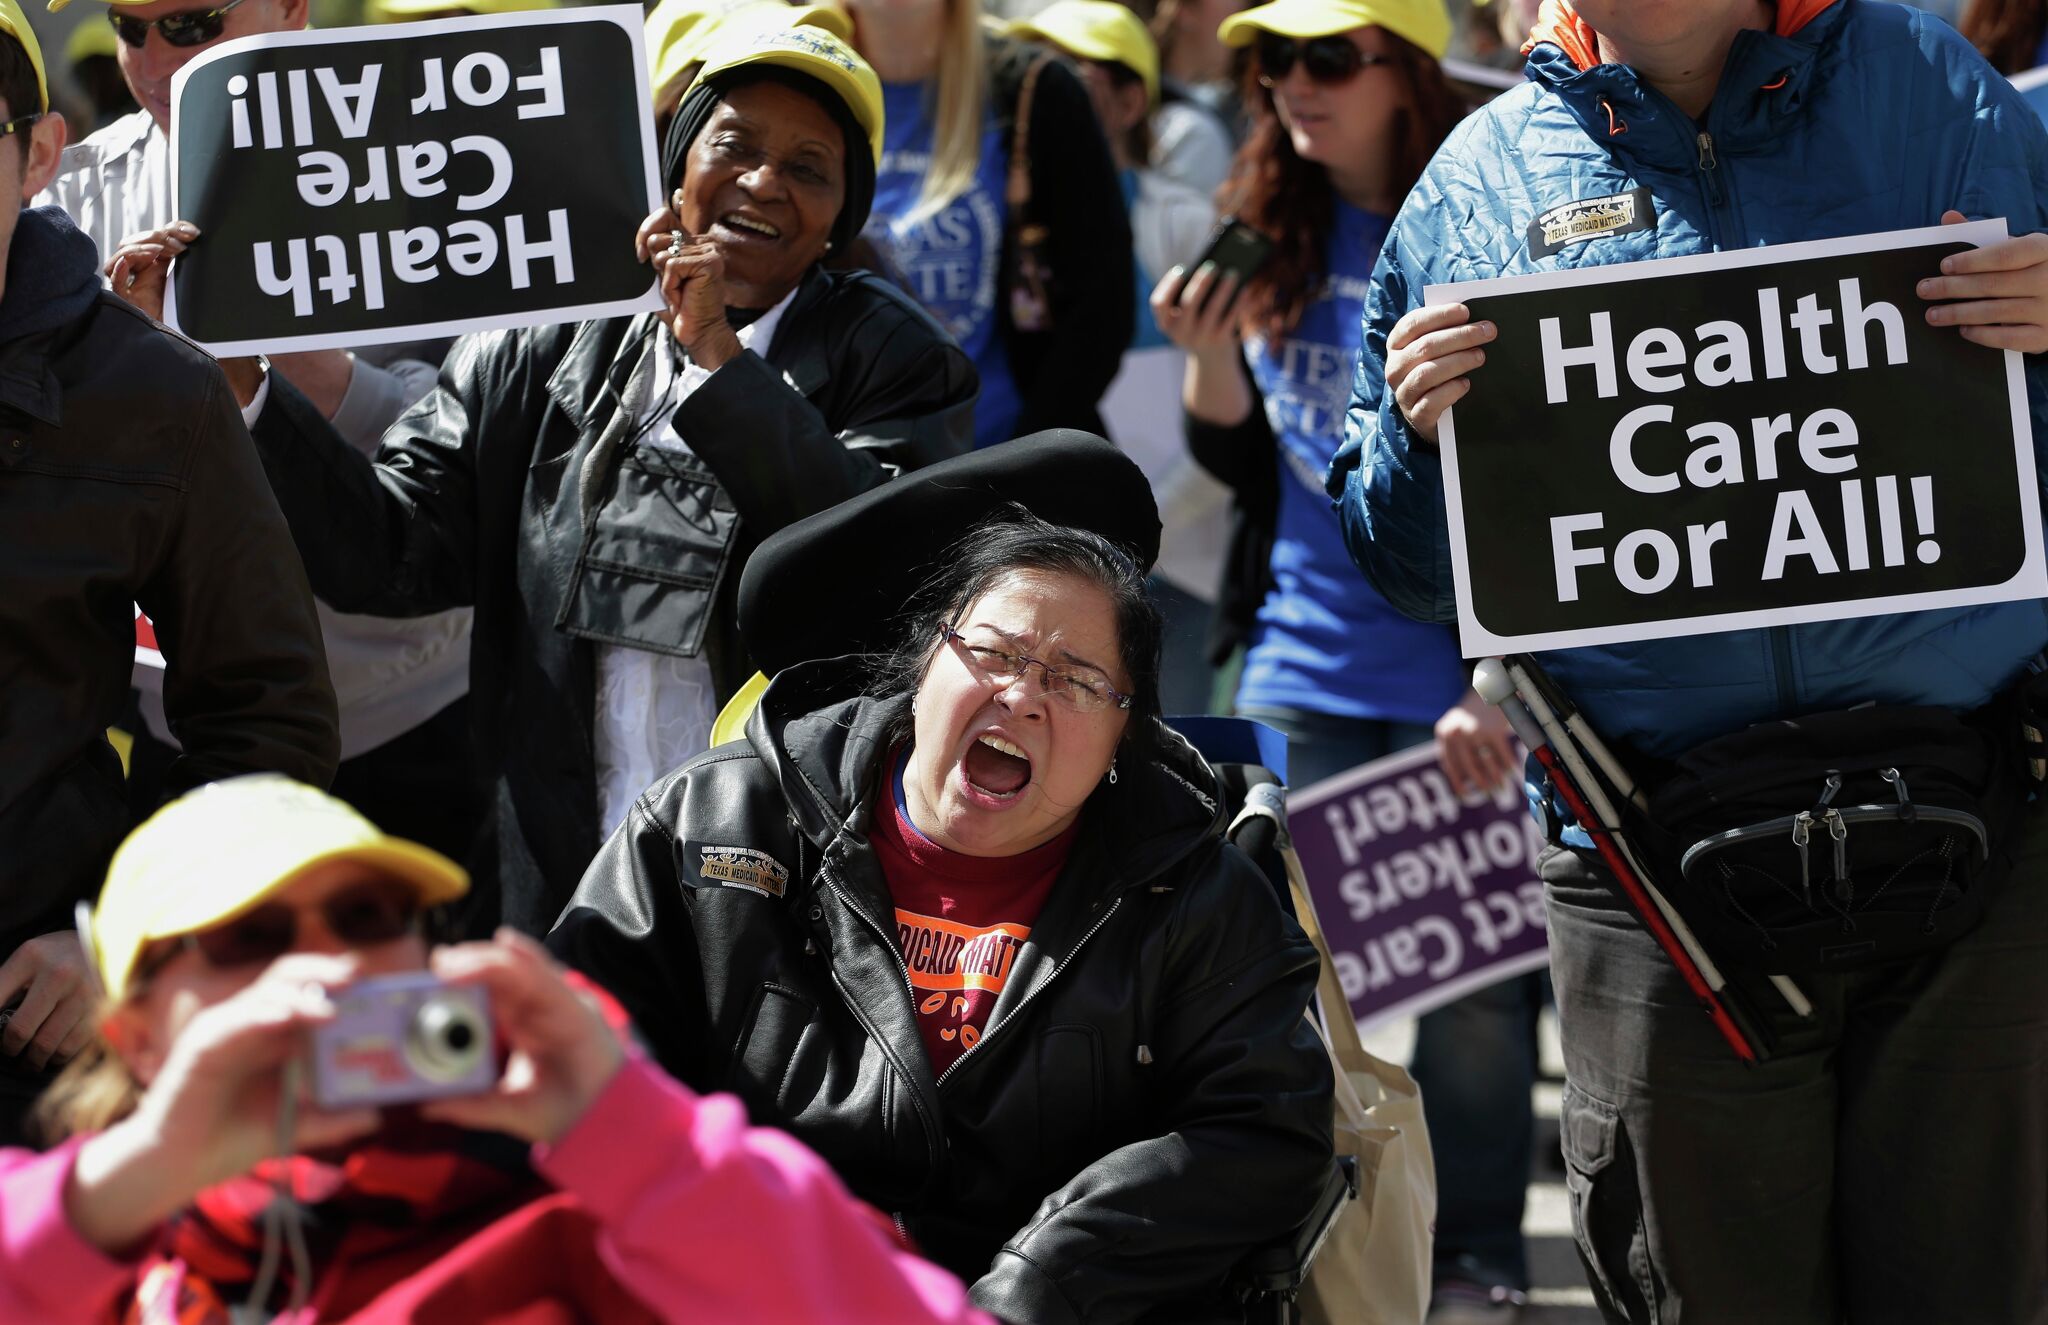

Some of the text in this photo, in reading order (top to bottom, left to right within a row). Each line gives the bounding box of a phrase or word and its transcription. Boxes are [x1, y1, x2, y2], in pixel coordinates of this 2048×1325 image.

[226, 46, 566, 149] For All!
[297, 135, 513, 211] Care
[253, 208, 575, 317] Health
[1552, 225, 1568, 240] TEXAS
[1570, 219, 1599, 234] MEDICAID
[1600, 212, 1626, 228] MATTERS
[1539, 277, 1908, 404] Health
[1608, 404, 1860, 494] Care
[1549, 474, 1942, 602] For All!
[1324, 768, 1519, 866] tter!
[709, 864, 729, 877] TEXAS
[731, 868, 758, 883] MEDICAID
[760, 873, 780, 893] MATTERS
[898, 921, 1027, 978] DICAID MATT
[1333, 881, 1548, 1001] ect Care
